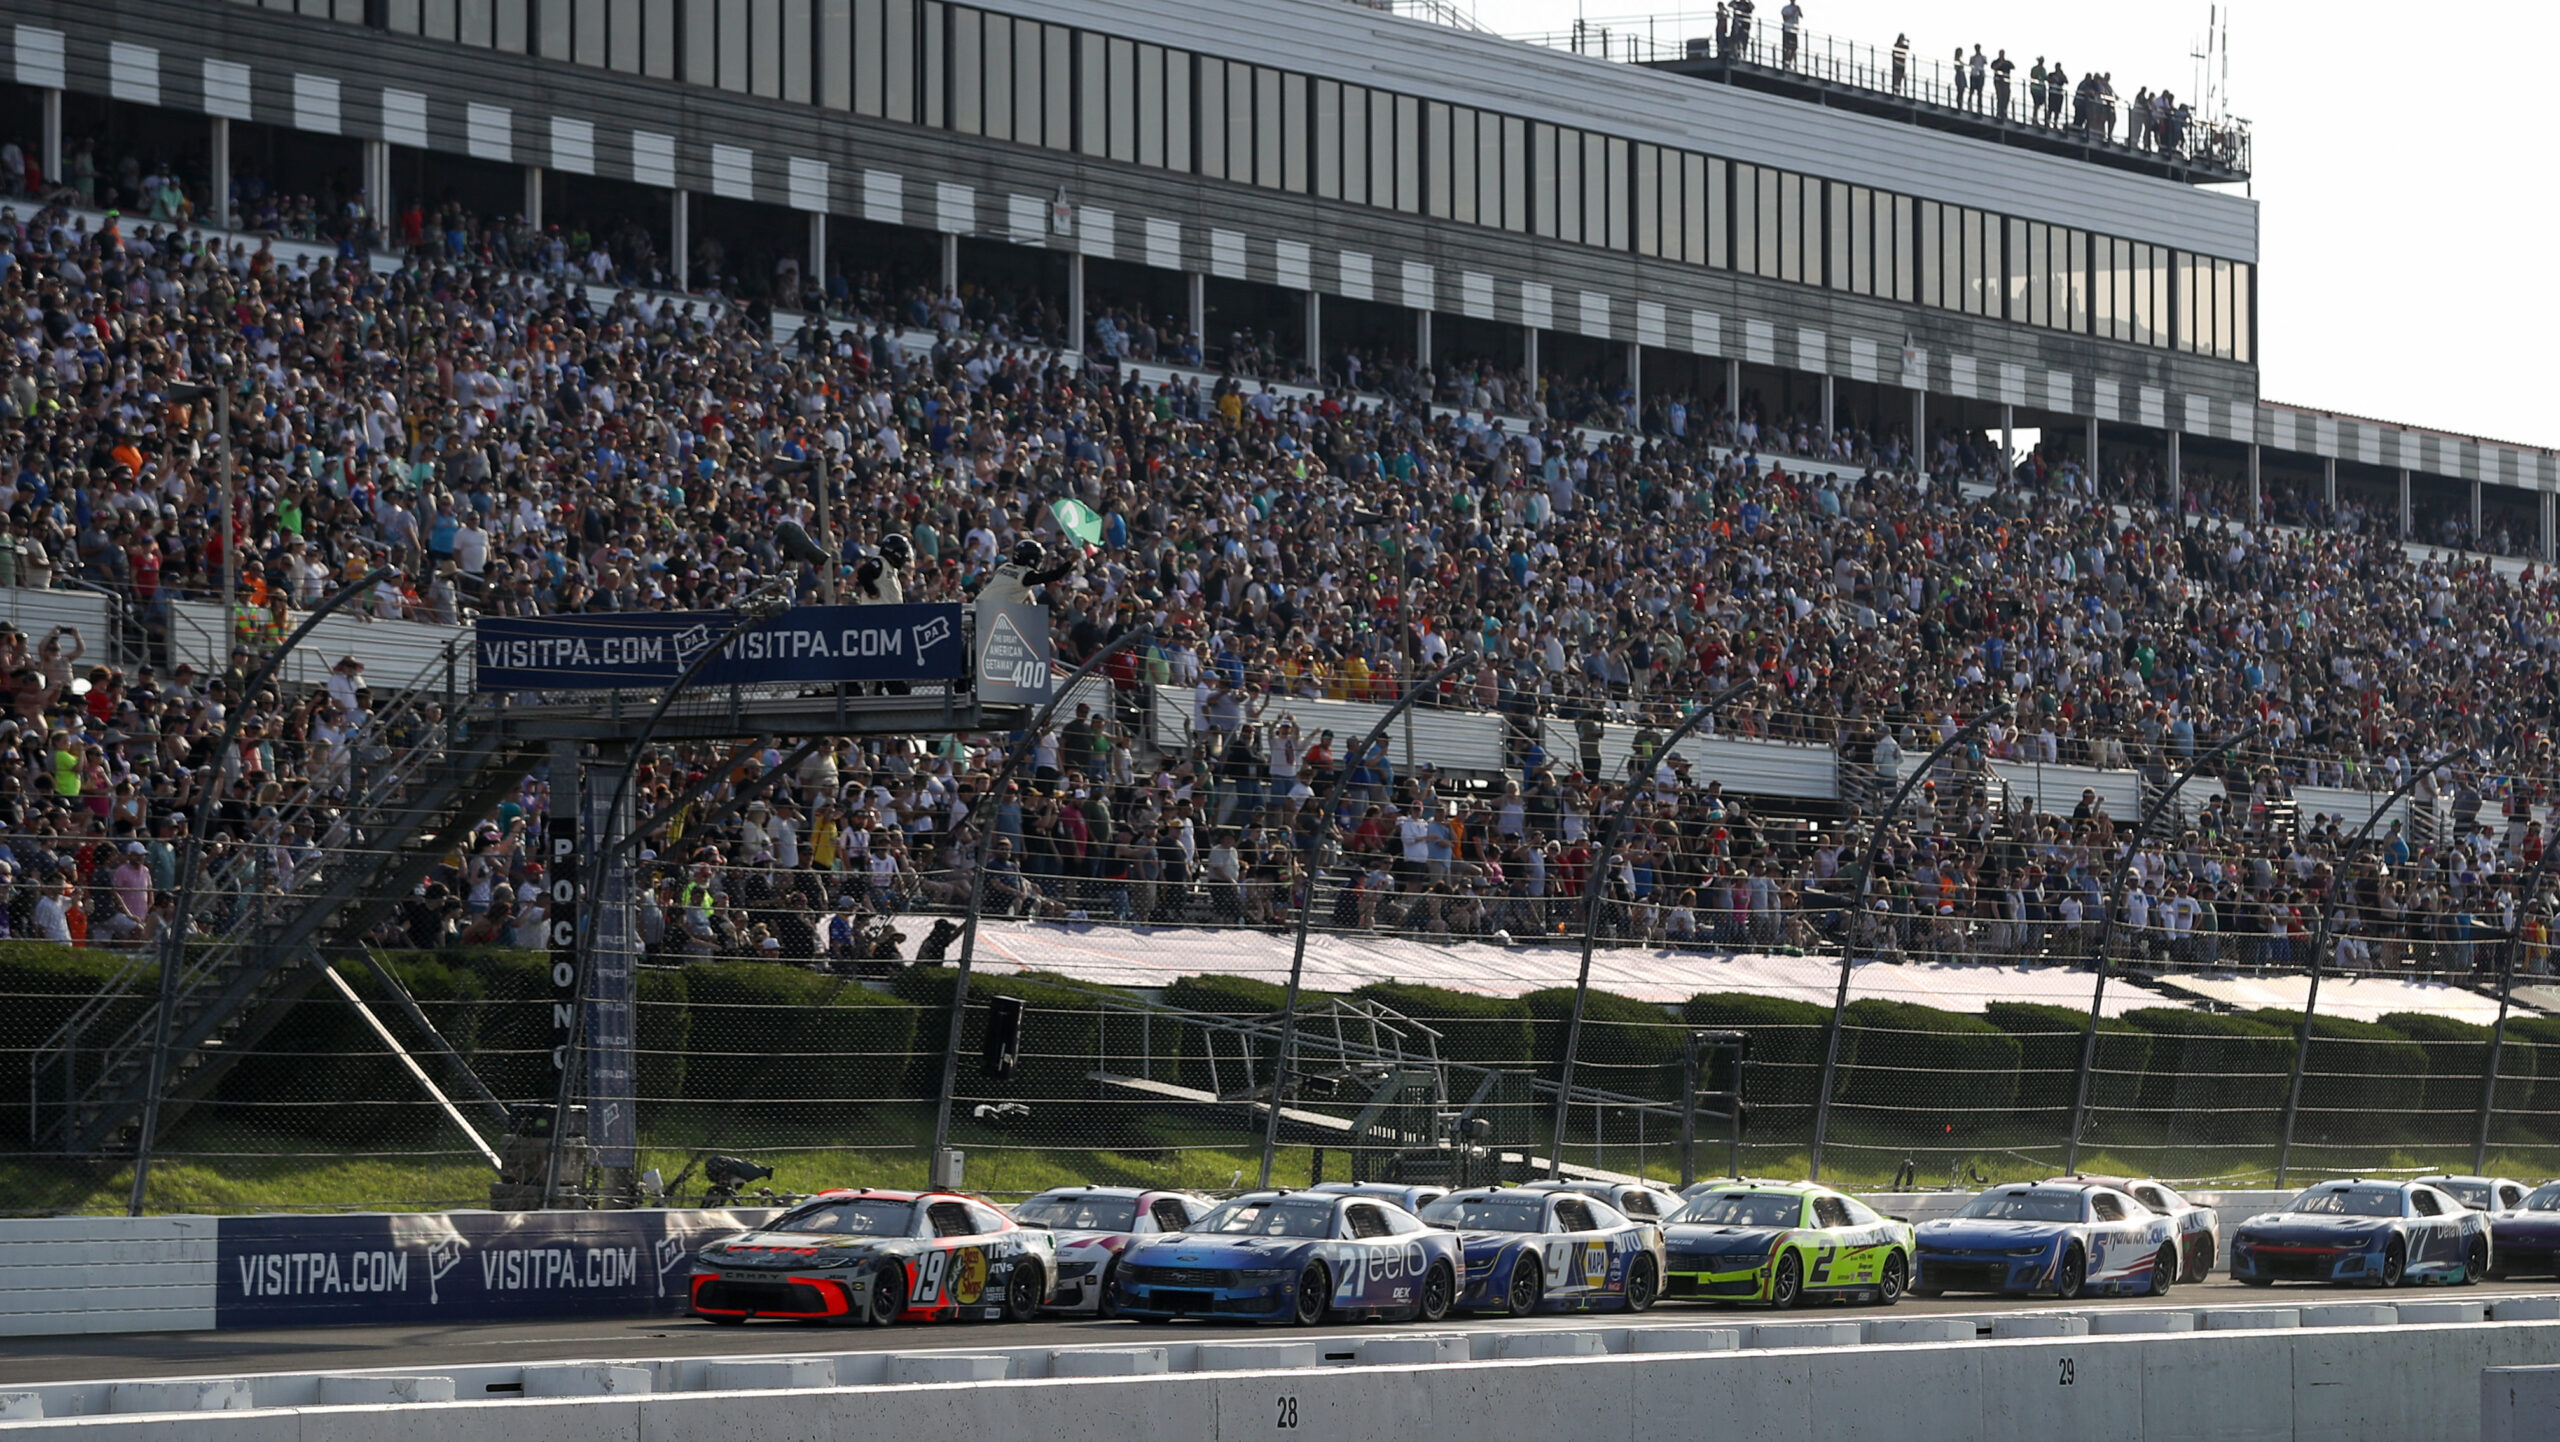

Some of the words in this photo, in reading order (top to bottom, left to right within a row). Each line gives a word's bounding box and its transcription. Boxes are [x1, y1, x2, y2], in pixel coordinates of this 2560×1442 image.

[684, 634, 699, 649] PA
[720, 628, 902, 660] VISITPA.COM
[924, 626, 939, 641] PA
[485, 636, 663, 668] VISITPA.COM
[985, 658, 1014, 671] GETAWAY
[989, 645, 1023, 657] AMERICAN
[1012, 660, 1046, 689] 400
[1612, 1230, 1642, 1254] AUTO
[2437, 1219, 2480, 1240] Delaware
[438, 1246, 451, 1269] PA
[664, 1241, 678, 1264] PA
[1368, 1241, 1427, 1282] eero
[1546, 1242, 1574, 1288] 9
[1587, 1249, 1606, 1274] NAPA
[1808, 1238, 1837, 1284] 2
[2088, 1232, 2110, 1276] 5
[239, 1251, 408, 1297] VISITPA.COM
[481, 1246, 637, 1290] VISITPA.COM
[725, 1271, 781, 1281] CAMRY
[912, 1251, 948, 1302] 19
[988, 1263, 1014, 1274] ATVs
[1336, 1247, 1369, 1298] 21
[1392, 1287, 1412, 1299] DEX
[2059, 1358, 2075, 1386] 29
[1277, 1396, 1298, 1429] 28
